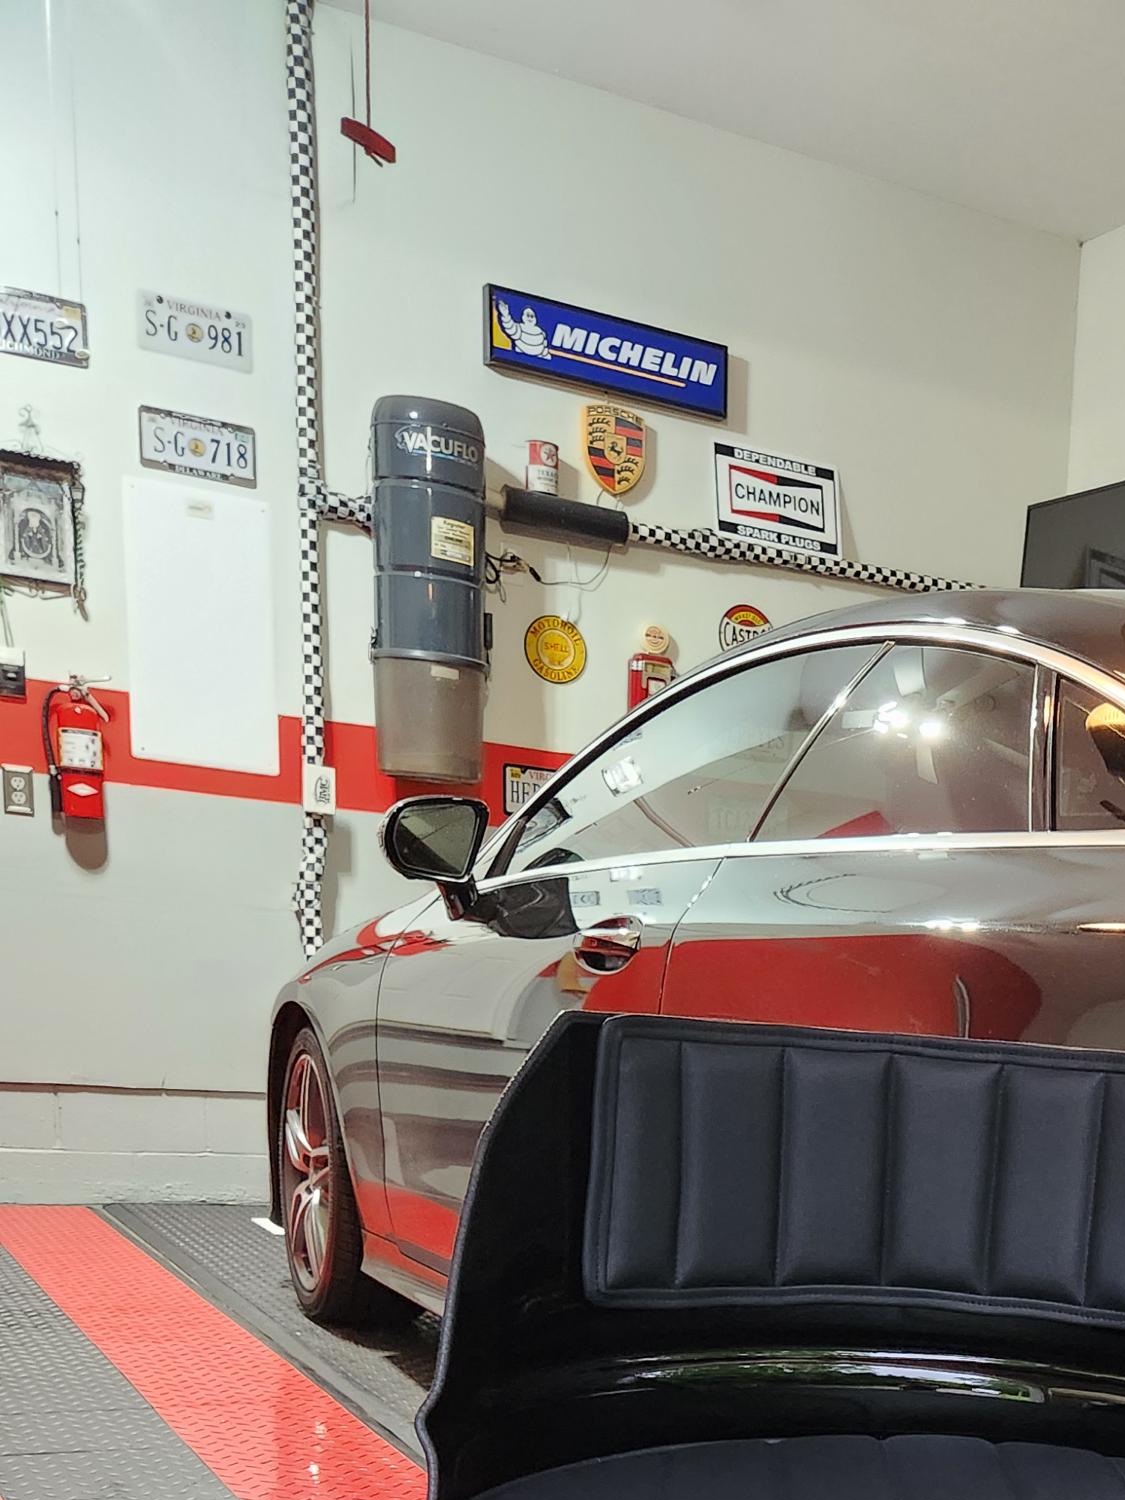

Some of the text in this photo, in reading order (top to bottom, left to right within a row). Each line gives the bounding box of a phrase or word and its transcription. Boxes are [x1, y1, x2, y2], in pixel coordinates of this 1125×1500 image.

[167, 300, 222, 321] VIRGINIA
[145, 309, 244, 356] S-G 981
[551, 323, 718, 386] MICHELIN
[587, 405, 644, 424] PORSCHE
[153, 426, 248, 469] S-G 718
[402, 430, 478, 462] VACUFLO
[733, 448, 817, 476] DEPENDABLE
[734, 482, 820, 516] CHAMPION
[736, 525, 821, 551] SPARK PLUGS
[723, 621, 771, 647] CASTR
[532, 658, 579, 681] GASOLINE
